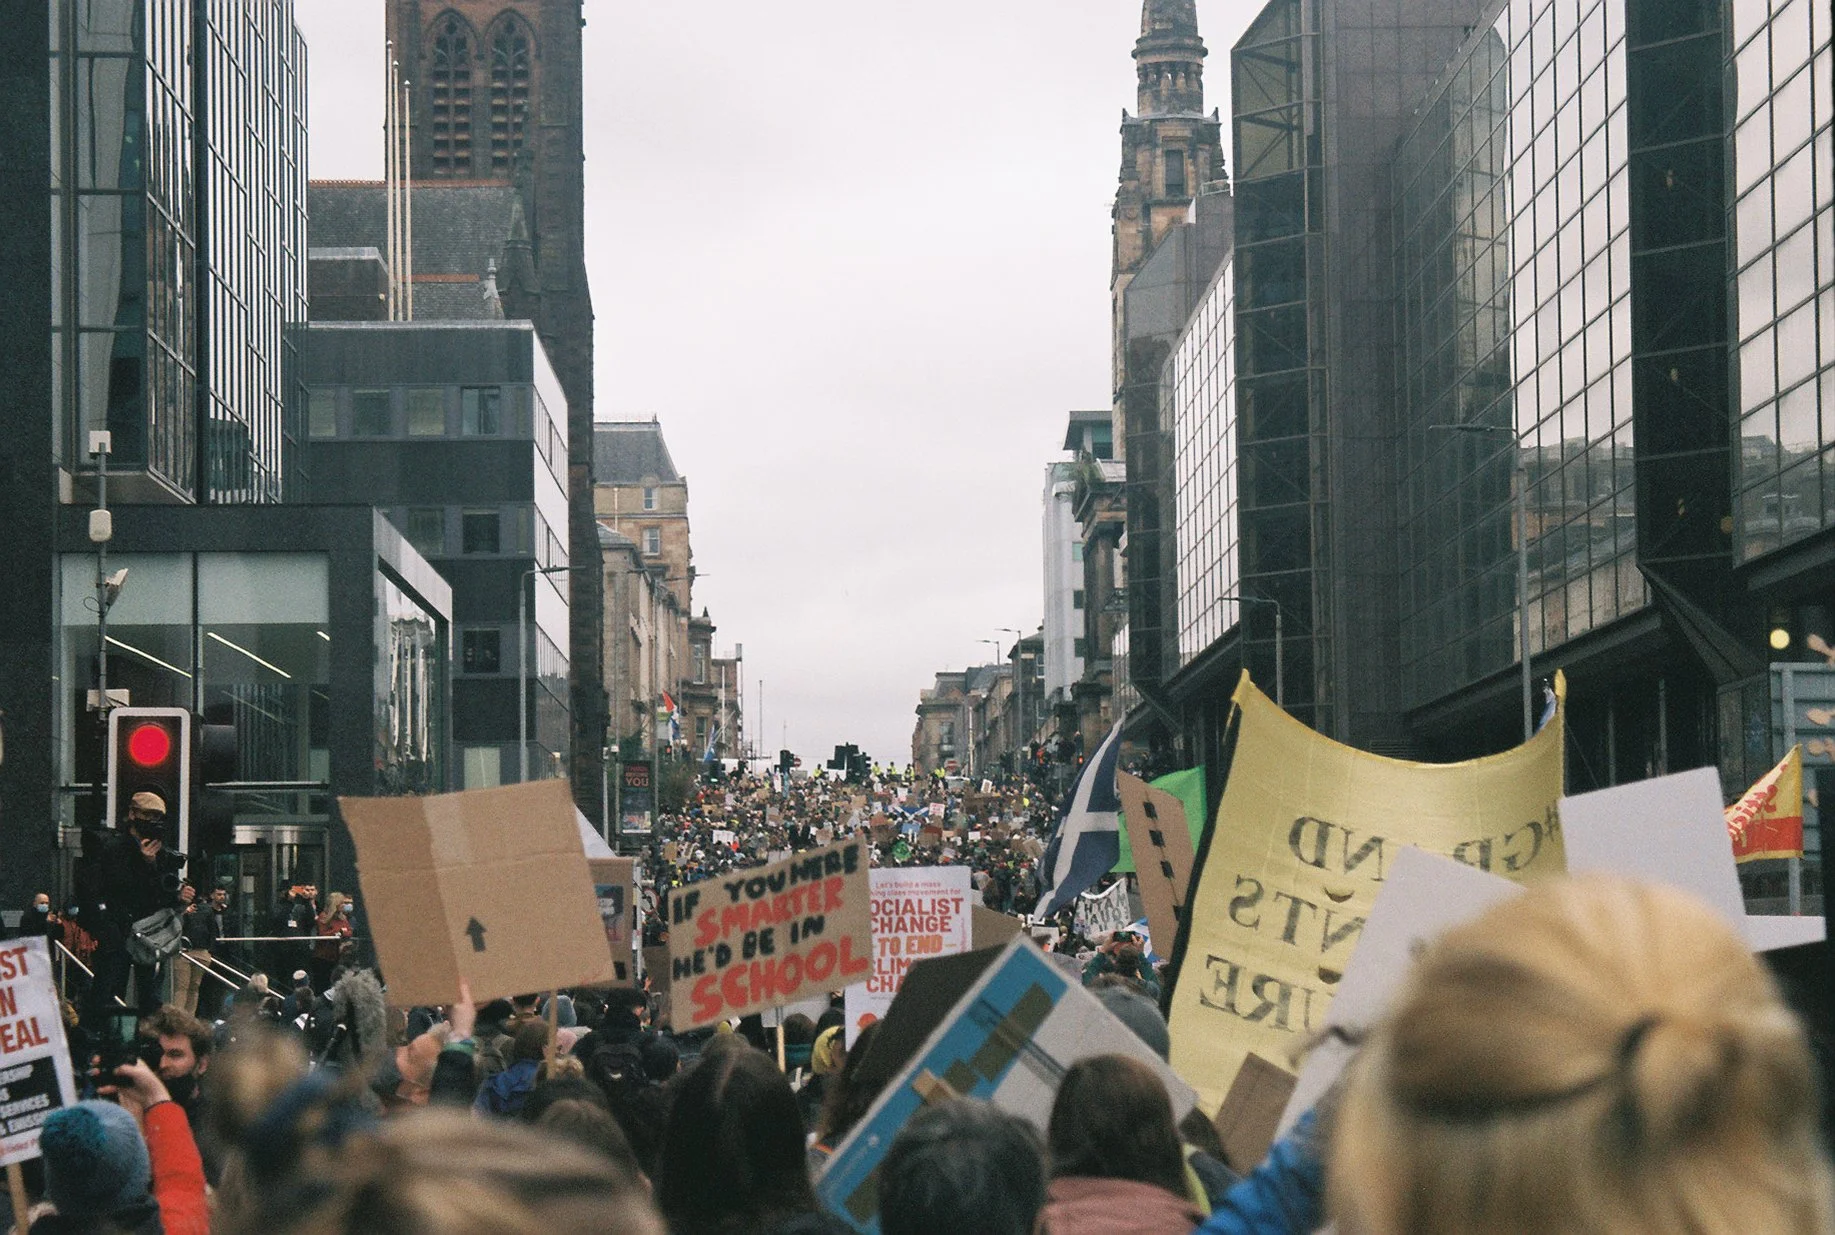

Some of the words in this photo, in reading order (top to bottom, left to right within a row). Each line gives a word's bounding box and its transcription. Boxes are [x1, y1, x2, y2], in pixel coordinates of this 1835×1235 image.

[626, 778, 649, 787] YOU
[673, 890, 699, 925] IF
[724, 869, 786, 902] YOU
[694, 876, 844, 948] SMARTER
[870, 897, 964, 916] OCIALIST
[672, 943, 732, 980] HE'D
[742, 927, 775, 960] BE
[790, 915, 825, 945] IN
[878, 937, 901, 957] TO
[905, 935, 943, 955] END
[691, 936, 869, 1024] SCHOOL
